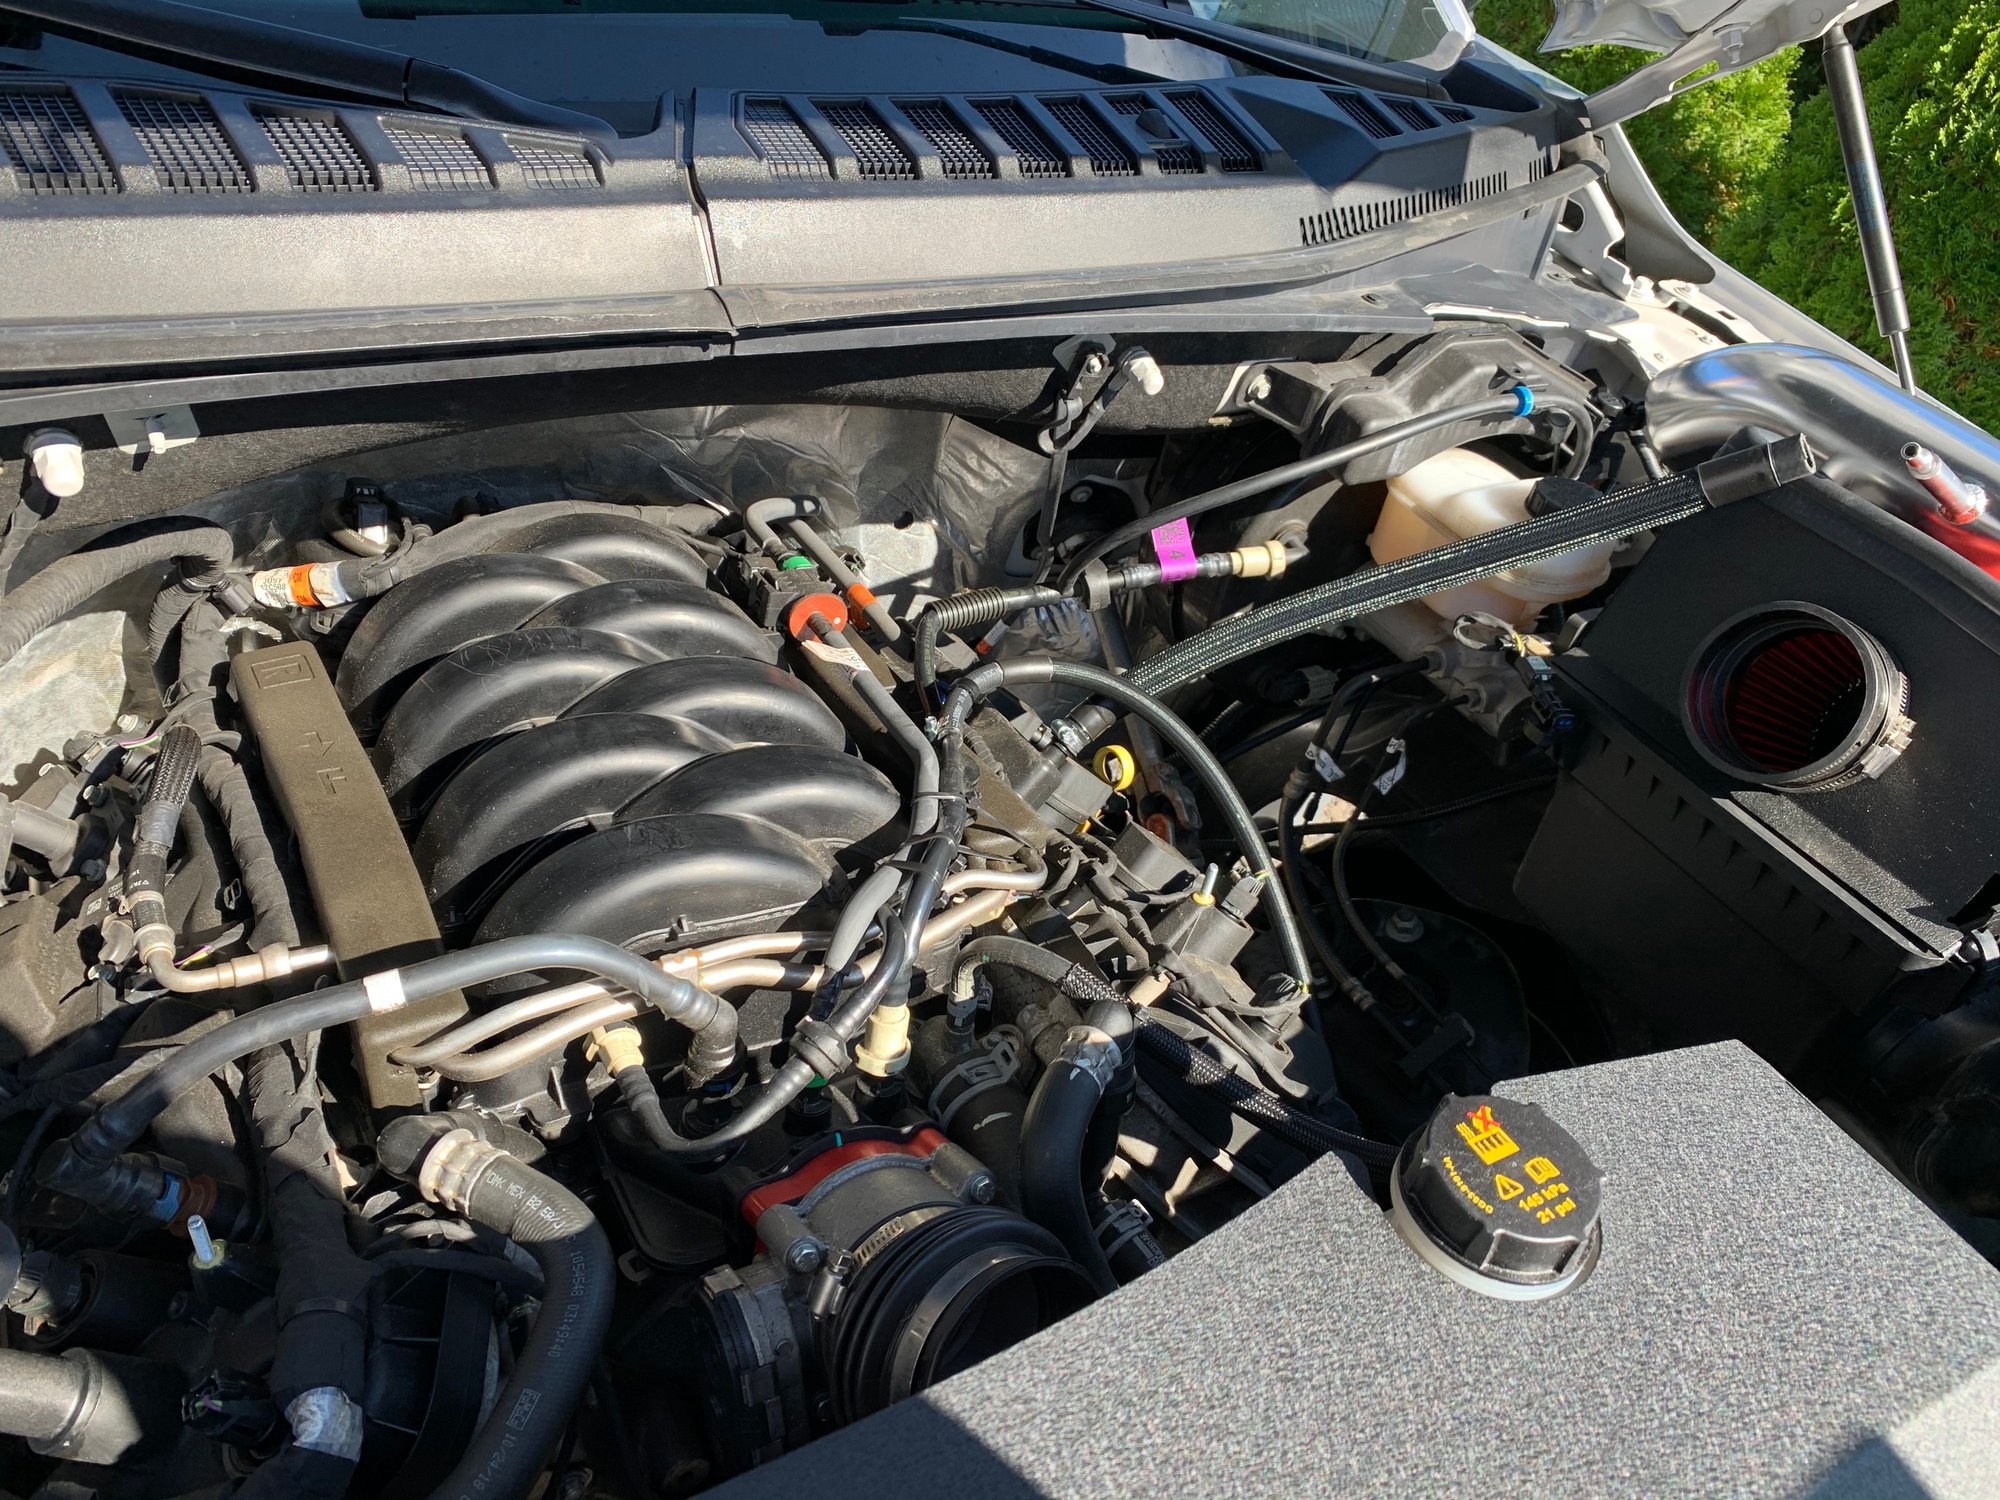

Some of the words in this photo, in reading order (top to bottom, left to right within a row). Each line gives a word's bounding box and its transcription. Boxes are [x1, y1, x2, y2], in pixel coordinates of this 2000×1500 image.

[526, 1195, 543, 1211] B2
[1518, 1192, 1545, 1213] 145
[1541, 1182, 1570, 1201] kPa
[1536, 1207, 1556, 1225] 21
[1555, 1196, 1577, 1218] psi
